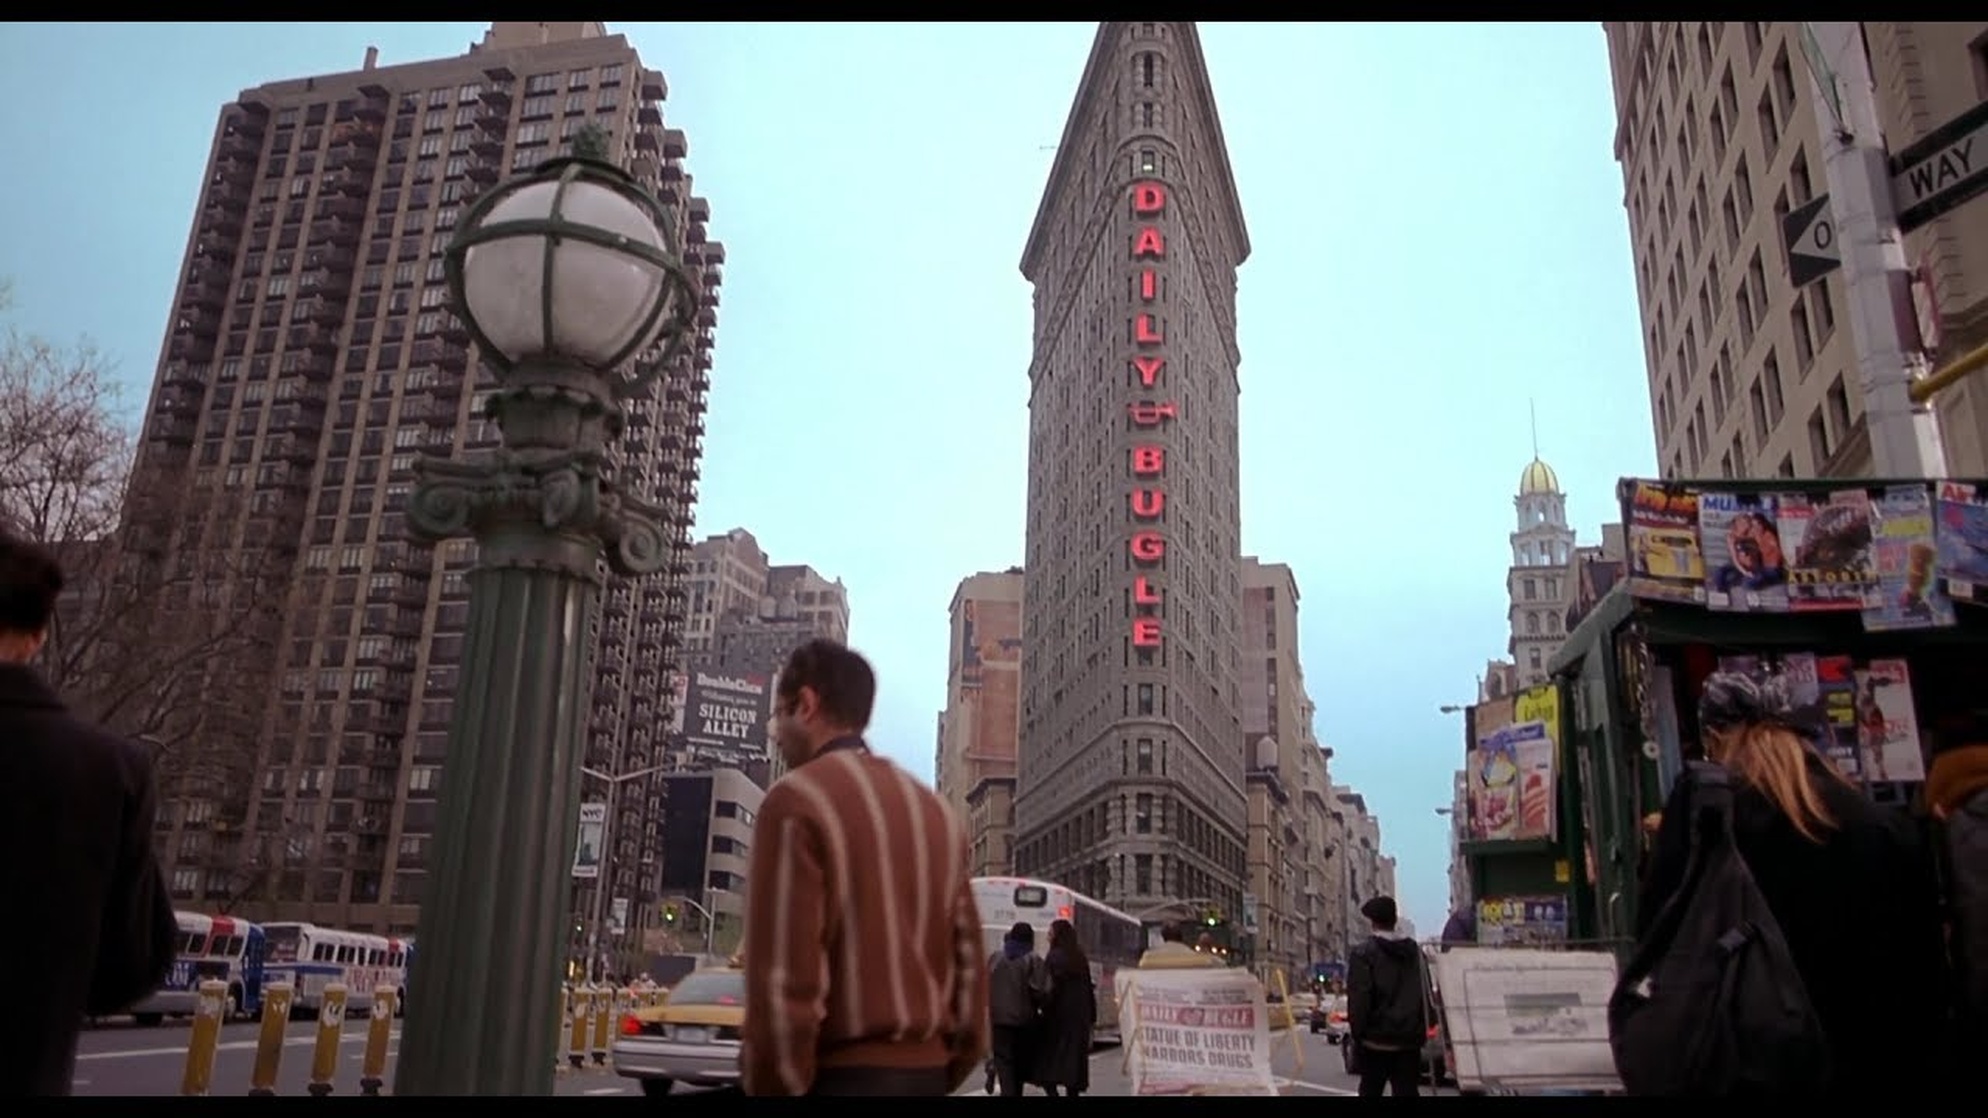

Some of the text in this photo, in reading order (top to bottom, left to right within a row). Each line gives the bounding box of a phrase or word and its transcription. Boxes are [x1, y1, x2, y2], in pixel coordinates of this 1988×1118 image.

[1909, 137, 1974, 199] WAY
[1131, 180, 1165, 647] DAILY BUGLE
[699, 703, 757, 724] SILICON
[703, 719, 749, 739] ALLEY
[1141, 1026, 1255, 1052] TATUE OF LIBERTY
[1208, 1051, 1253, 1069] DRUGS
